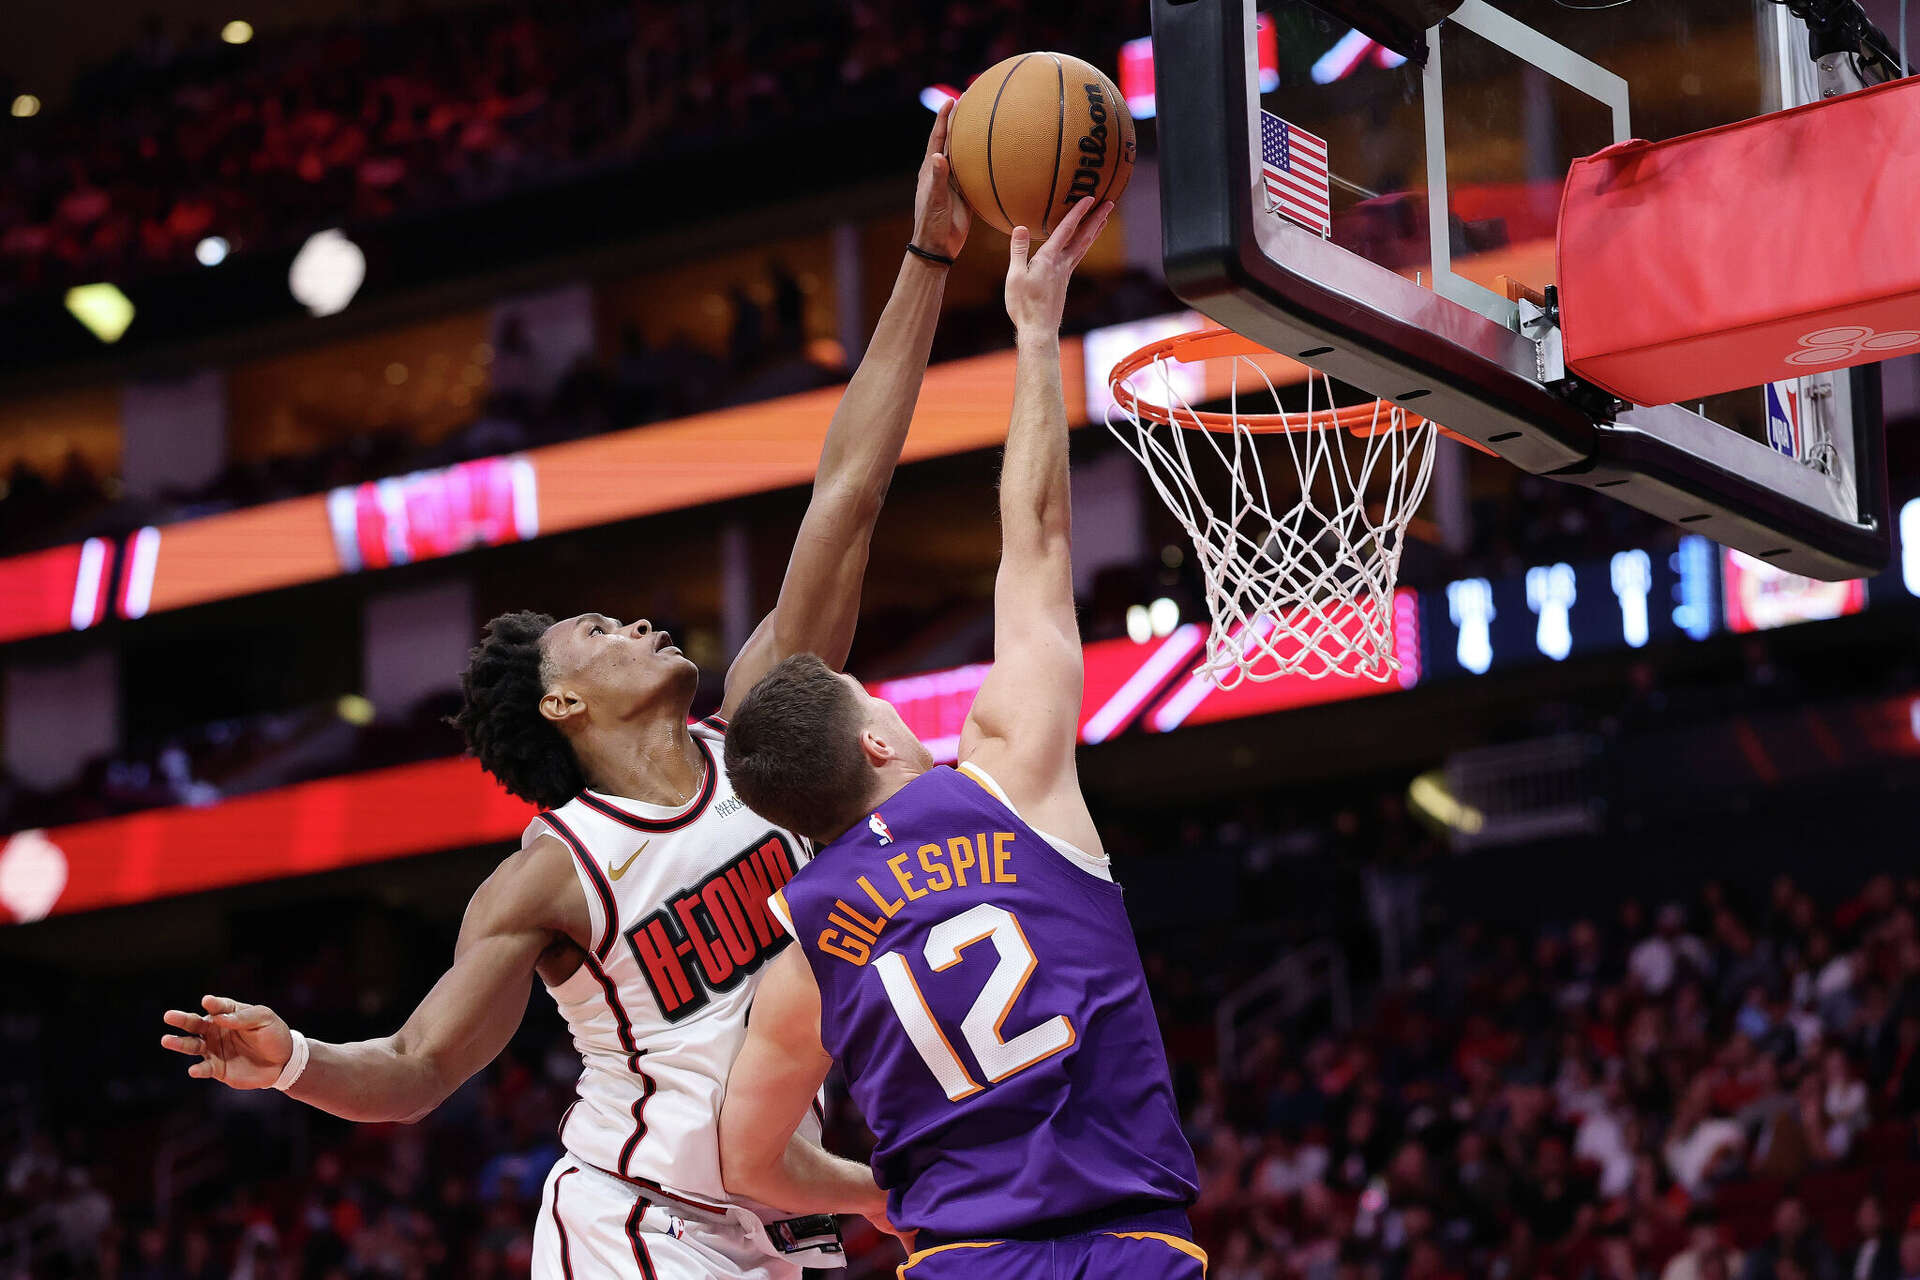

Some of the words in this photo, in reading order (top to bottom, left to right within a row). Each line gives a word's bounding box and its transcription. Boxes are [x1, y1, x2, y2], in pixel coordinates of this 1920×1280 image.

[1064, 83, 1107, 203] Wilson
[817, 832, 1017, 967] GILLESPIE
[870, 902, 1076, 1102] 12
